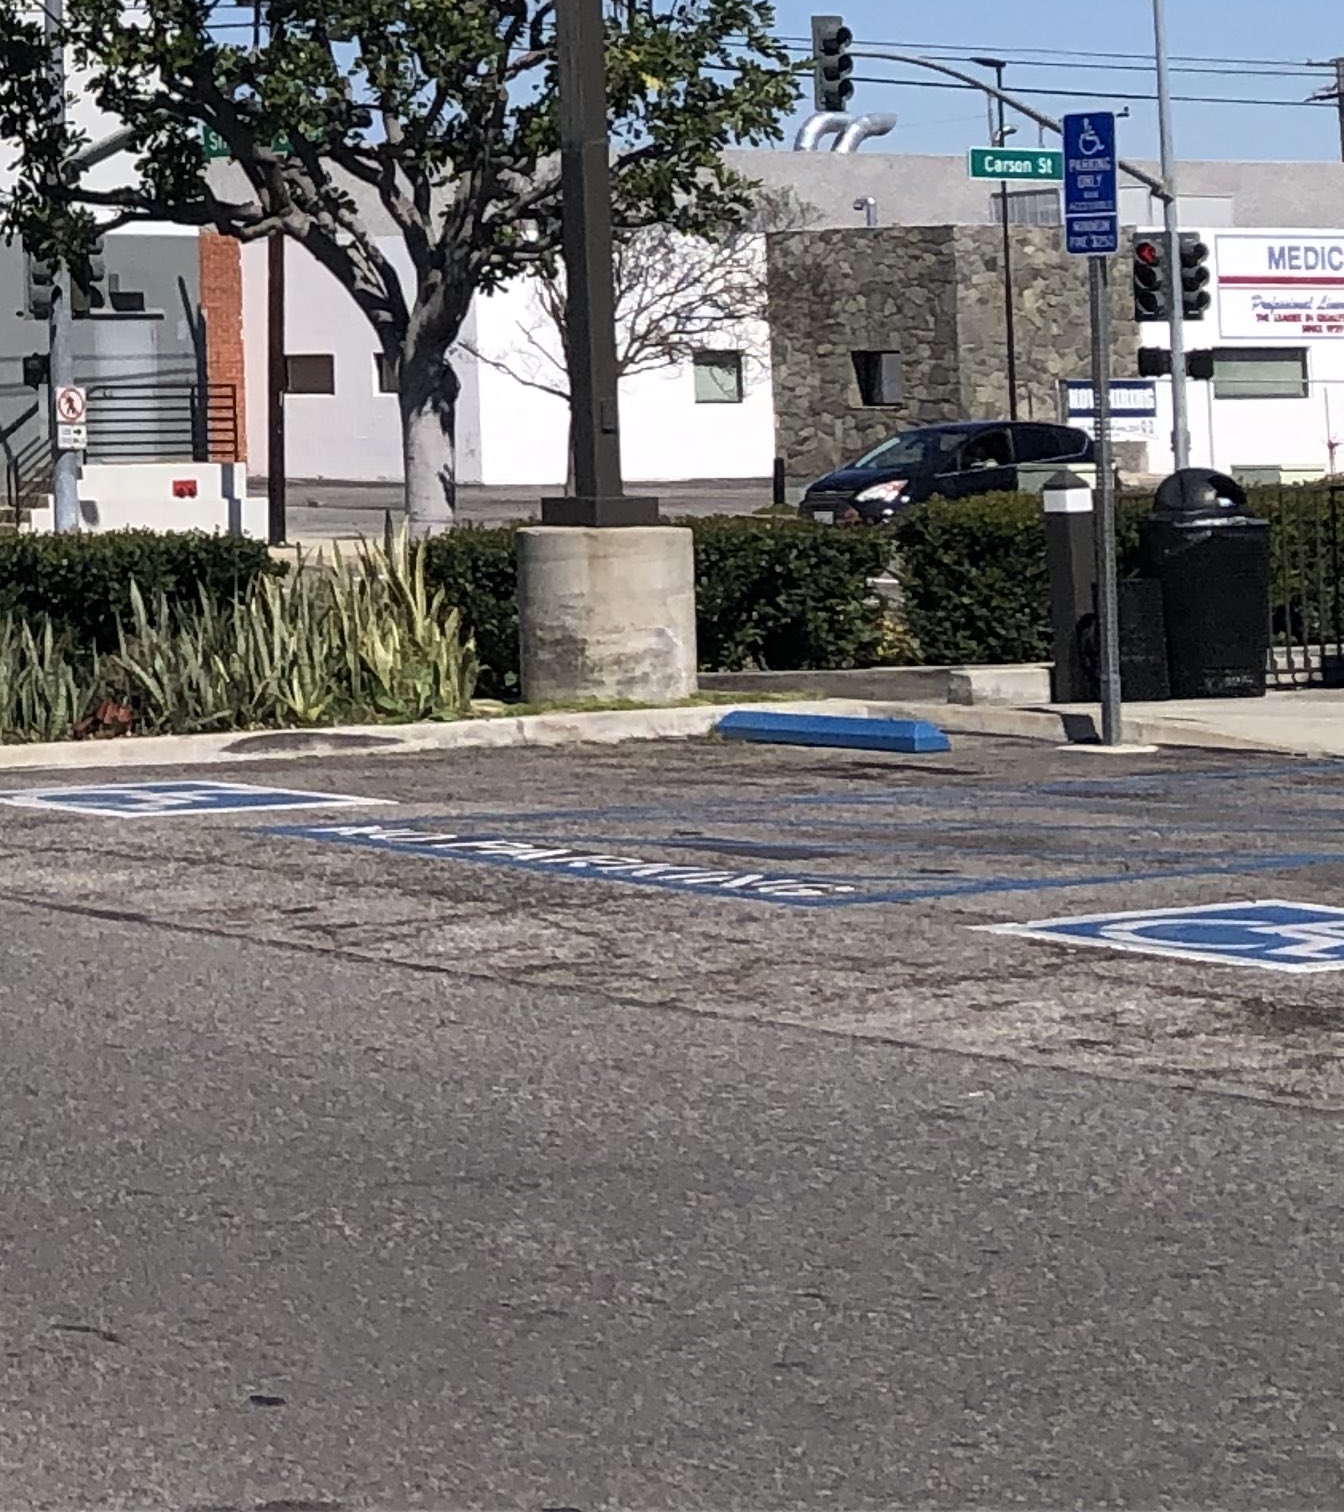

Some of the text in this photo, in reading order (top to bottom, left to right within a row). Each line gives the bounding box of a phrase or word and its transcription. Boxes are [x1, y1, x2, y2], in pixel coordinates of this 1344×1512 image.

[984, 155, 1053, 174] Carson St
[1069, 157, 1111, 172] PARKING
[431, 839, 855, 896] PARKING
